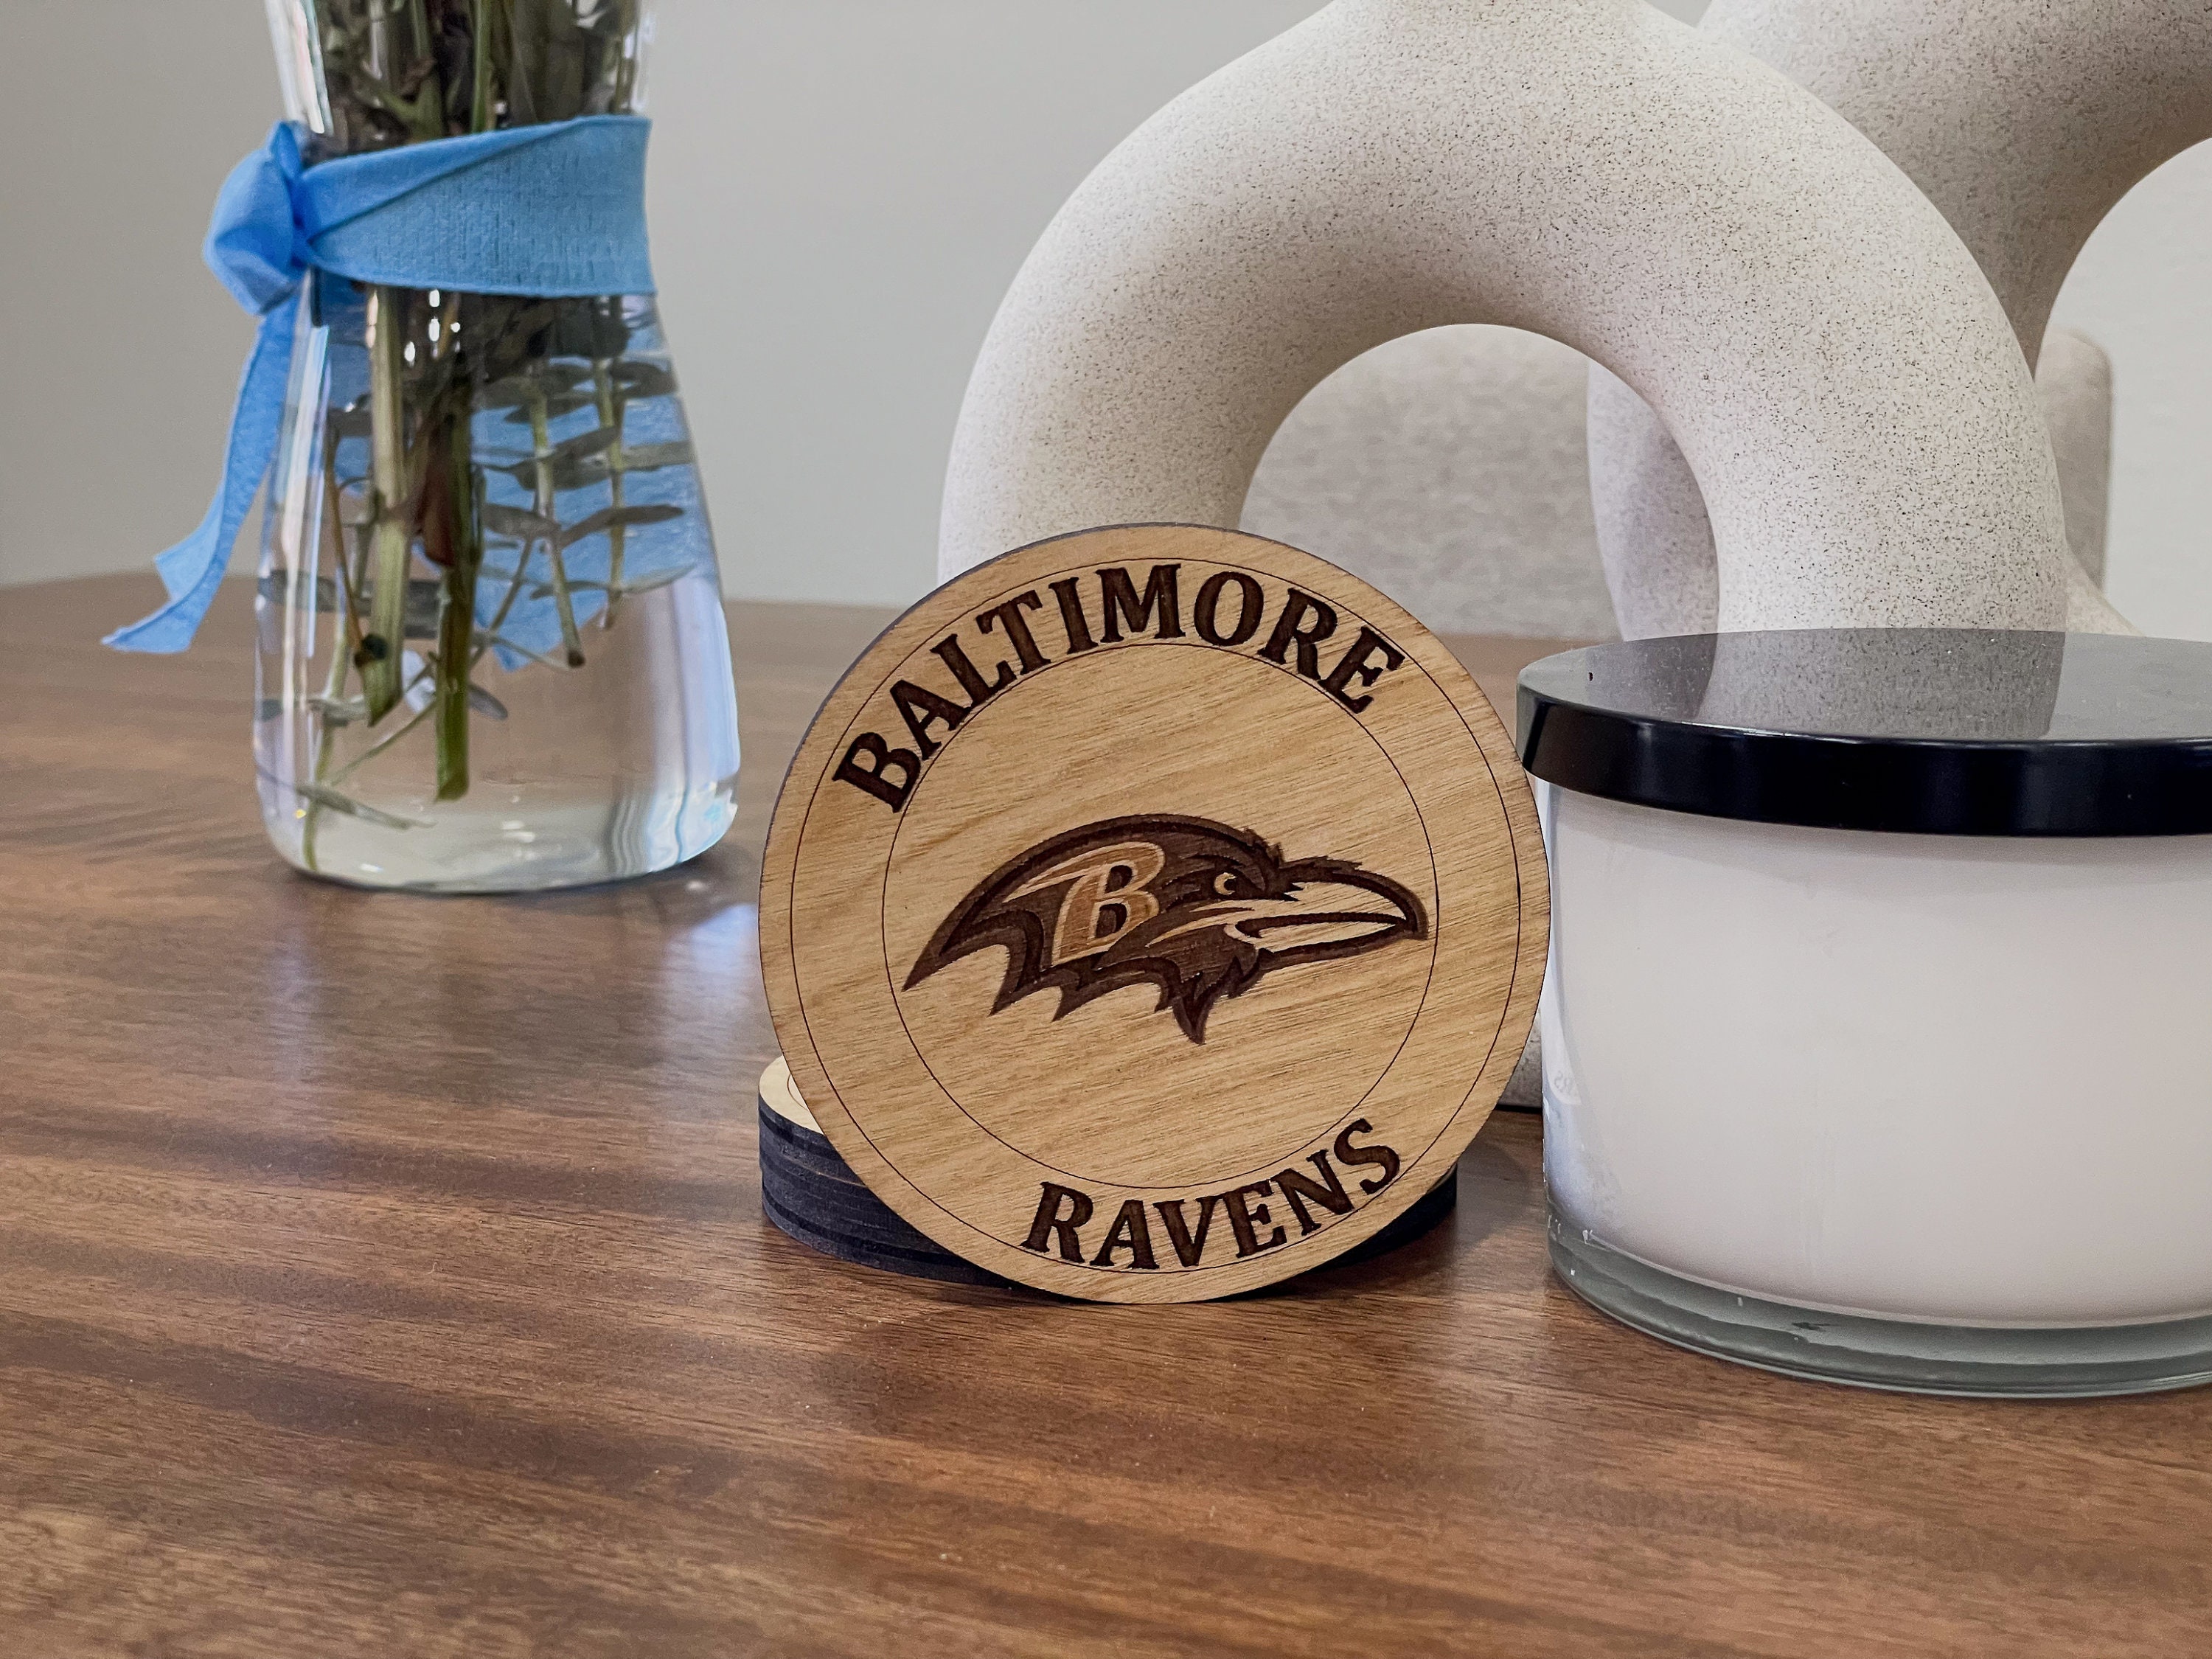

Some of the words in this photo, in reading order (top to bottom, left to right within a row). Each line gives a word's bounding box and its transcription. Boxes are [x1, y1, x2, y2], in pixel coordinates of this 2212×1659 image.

[832, 564, 1405, 813] BALTIMORE
[1007, 841, 1166, 966] B
[1018, 1117, 1402, 1271] RAVENS
